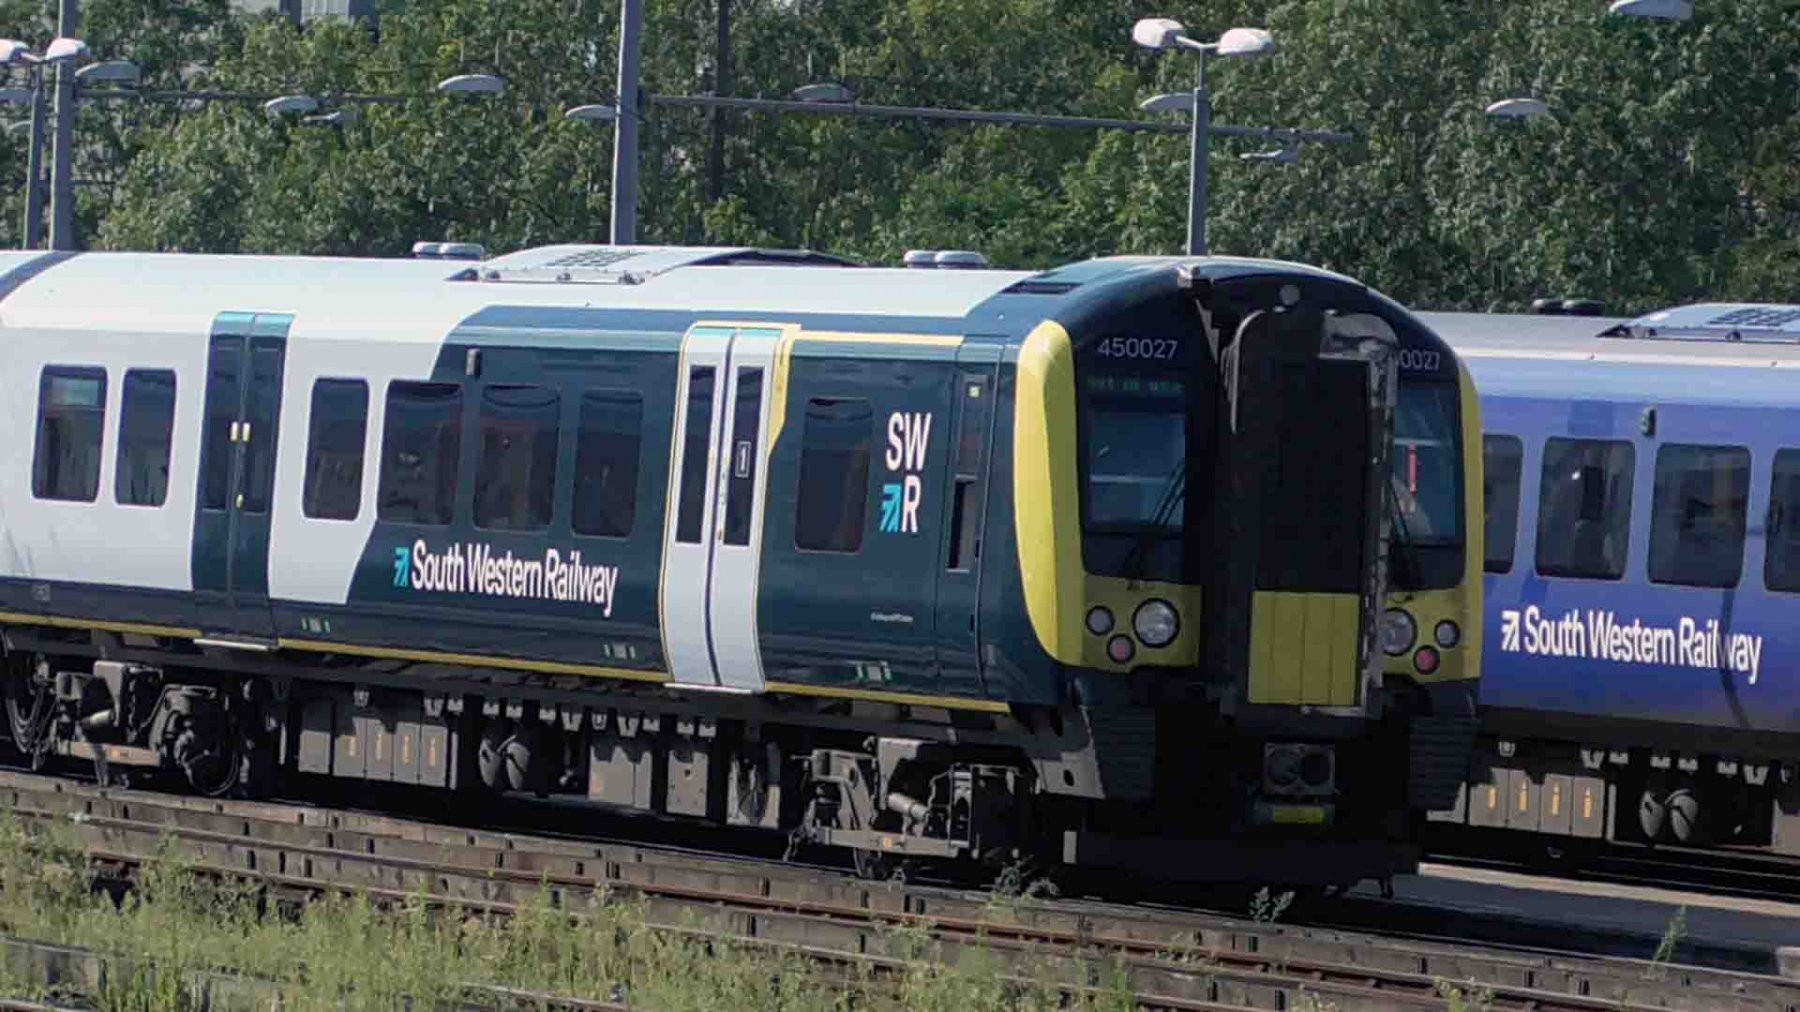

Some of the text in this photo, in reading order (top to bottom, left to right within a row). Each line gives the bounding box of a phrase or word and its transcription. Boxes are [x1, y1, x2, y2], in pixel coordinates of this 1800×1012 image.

[1097, 337, 1178, 359] 450027
[885, 411, 932, 471] SW
[901, 474, 922, 533] R
[411, 539, 618, 618] South Western Railway
[1524, 605, 1763, 685] South Western Railway
